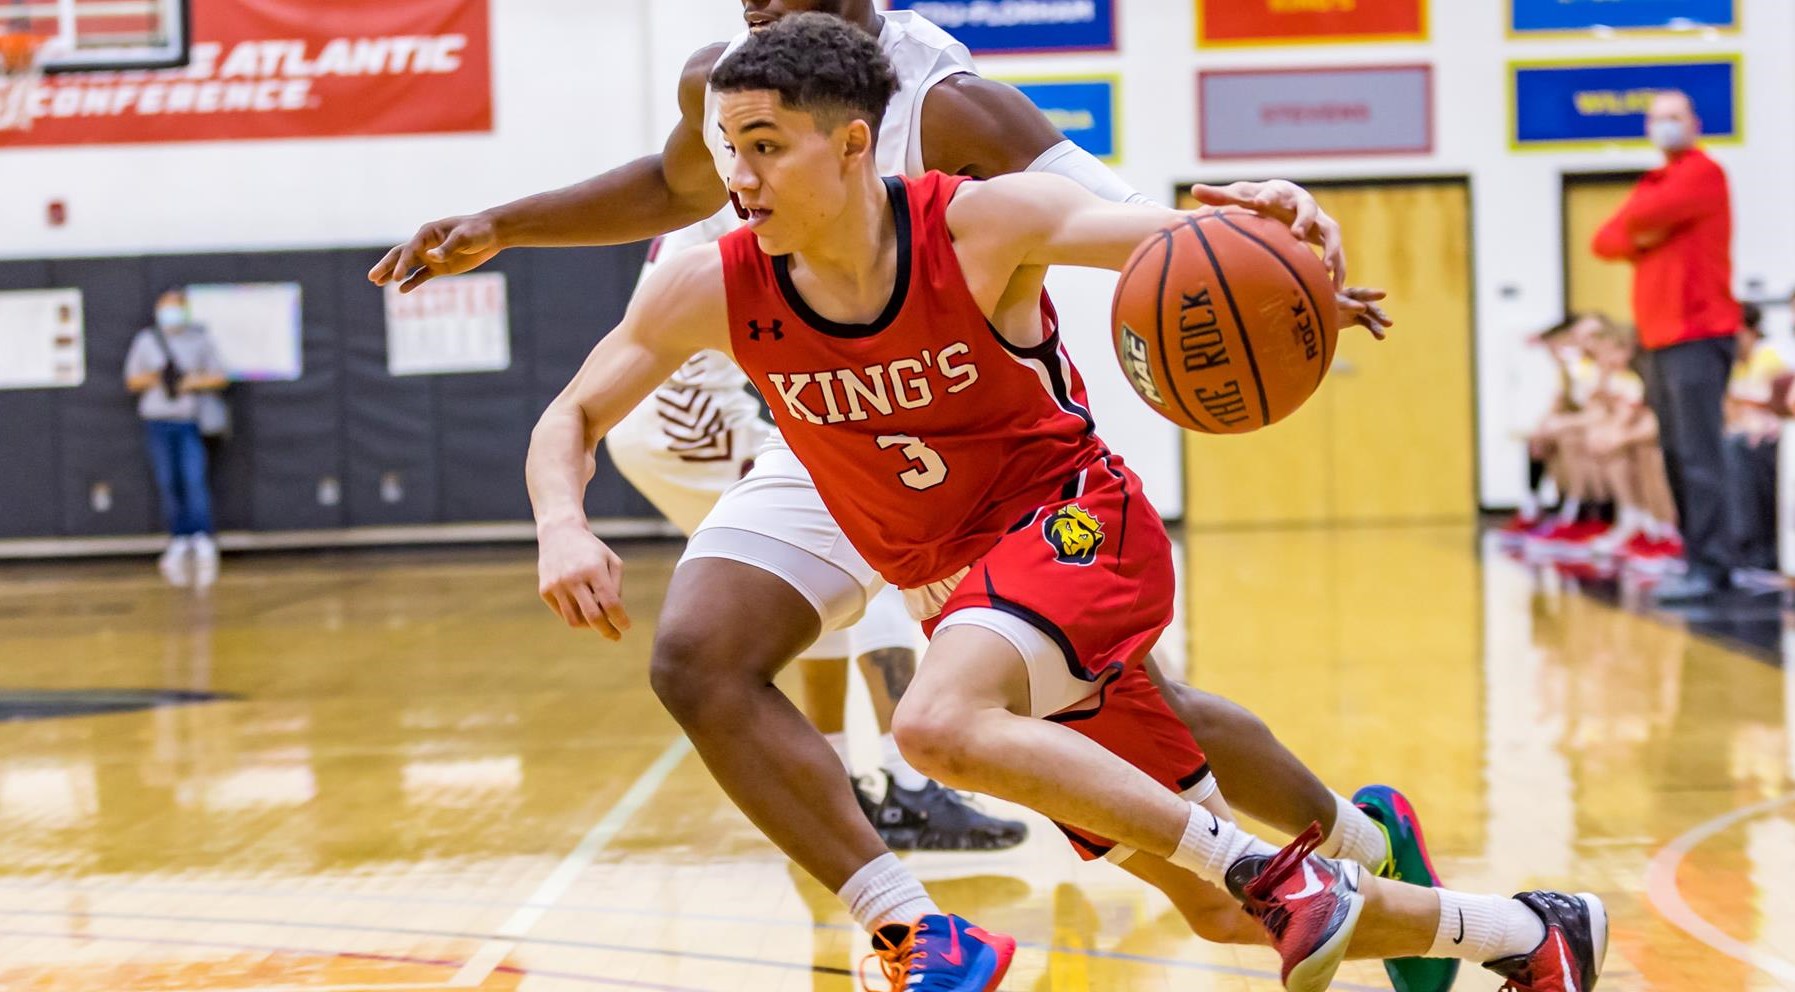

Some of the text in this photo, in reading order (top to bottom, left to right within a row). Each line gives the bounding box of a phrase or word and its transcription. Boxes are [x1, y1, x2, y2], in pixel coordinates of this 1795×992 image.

[220, 34, 466, 79] ATLANTIC
[1179, 287, 1249, 426] THE ROCK
[1291, 299, 1319, 361] ROCK
[767, 341, 979, 425] KING'S
[876, 433, 948, 492] 3
